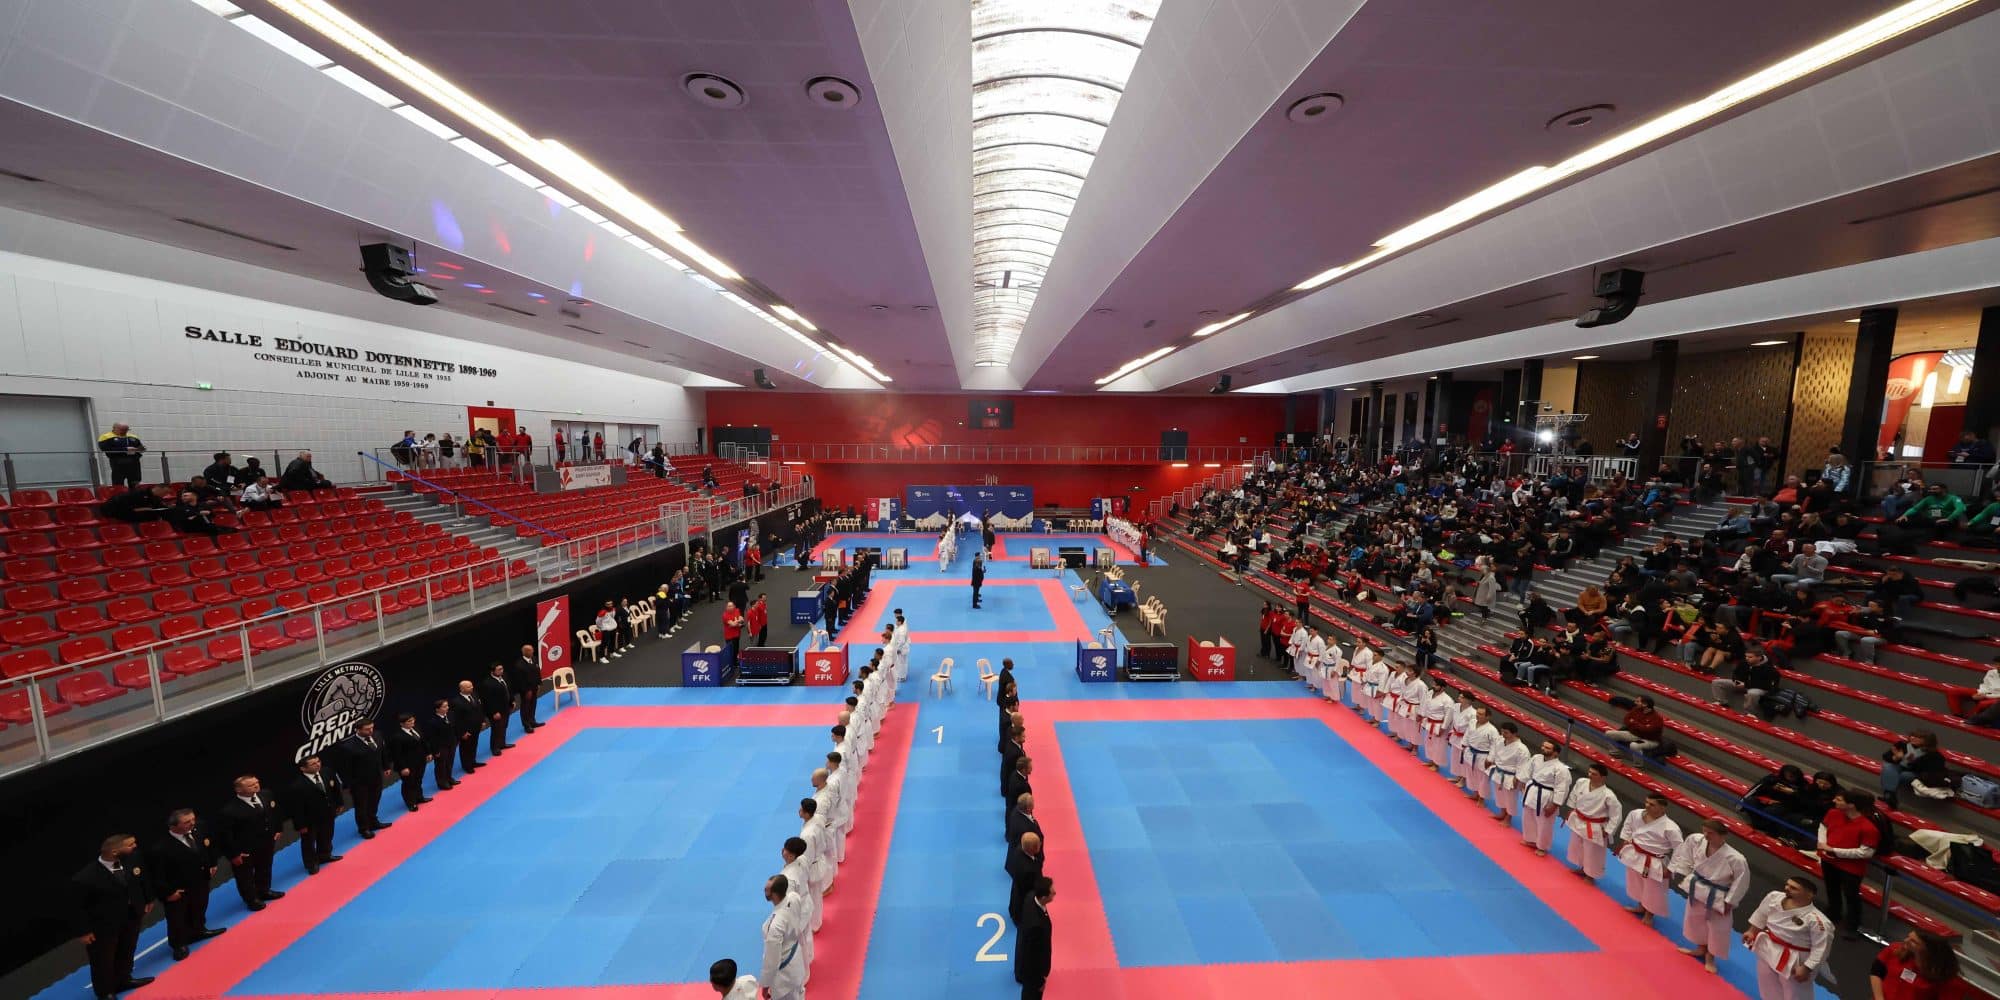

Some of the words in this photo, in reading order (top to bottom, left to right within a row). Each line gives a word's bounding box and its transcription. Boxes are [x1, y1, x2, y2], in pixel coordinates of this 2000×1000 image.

[185, 326, 262, 347] SALLE
[274, 338, 359, 360] EDOUARD
[365, 350, 456, 373] DOYENNETTE
[458, 364, 497, 378] 1898-1969
[254, 352, 322, 367] CONSEILLER
[326, 361, 377, 374] MUNICIPAL
[381, 367, 392, 375] DE
[396, 369, 420, 378] LILLE
[296, 370, 340, 381] ADJOINT
[345, 375, 357, 383] AU
[362, 376, 391, 386] MAIRE
[315, 672, 334, 691] LILLE
[310, 710, 350, 741] RED
[932, 725, 944, 745] 1
[975, 912, 1008, 962] 2
